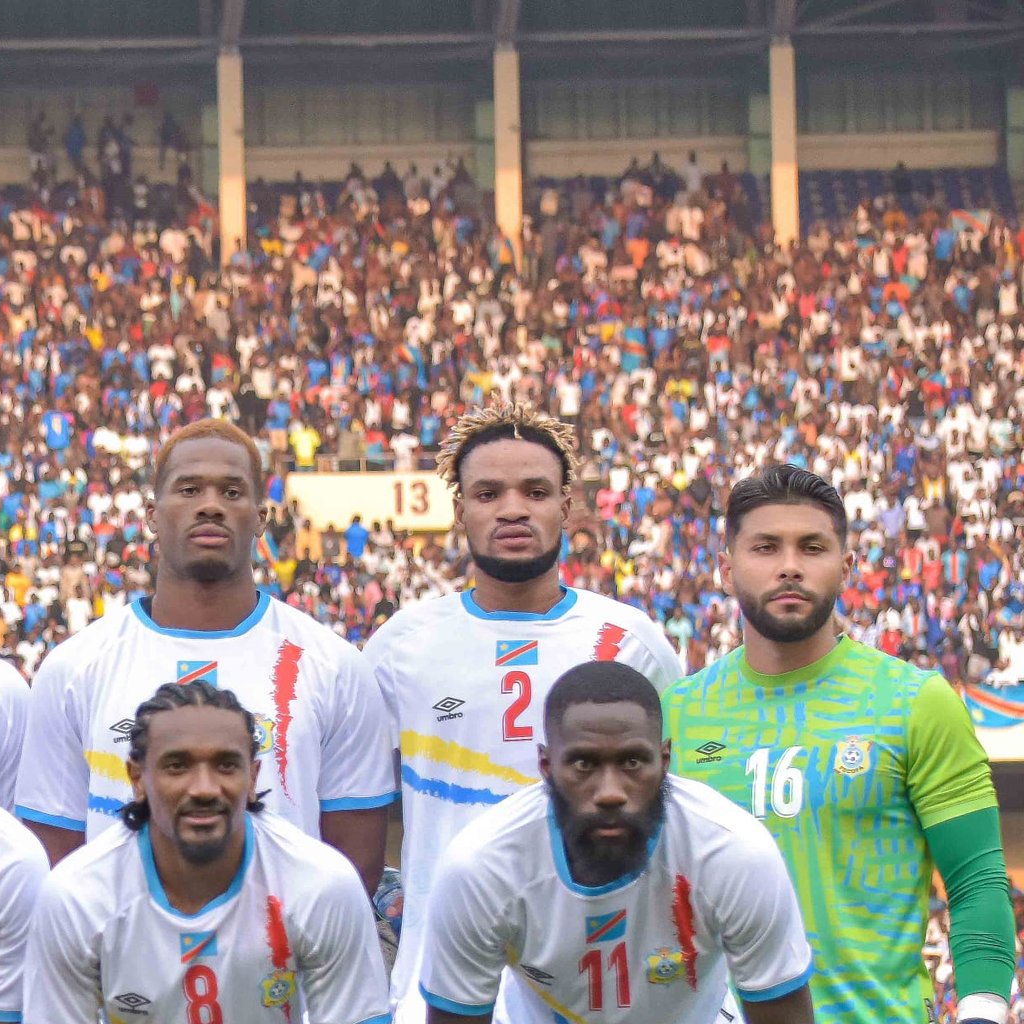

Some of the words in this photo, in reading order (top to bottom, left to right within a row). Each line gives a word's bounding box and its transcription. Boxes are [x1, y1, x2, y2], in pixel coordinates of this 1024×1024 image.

[395, 482, 429, 515] 13
[437, 711, 464, 722] umbro
[501, 671, 533, 742] 2
[696, 755, 722, 764] umbro
[745, 745, 805, 820] 16
[578, 941, 631, 1012] 11
